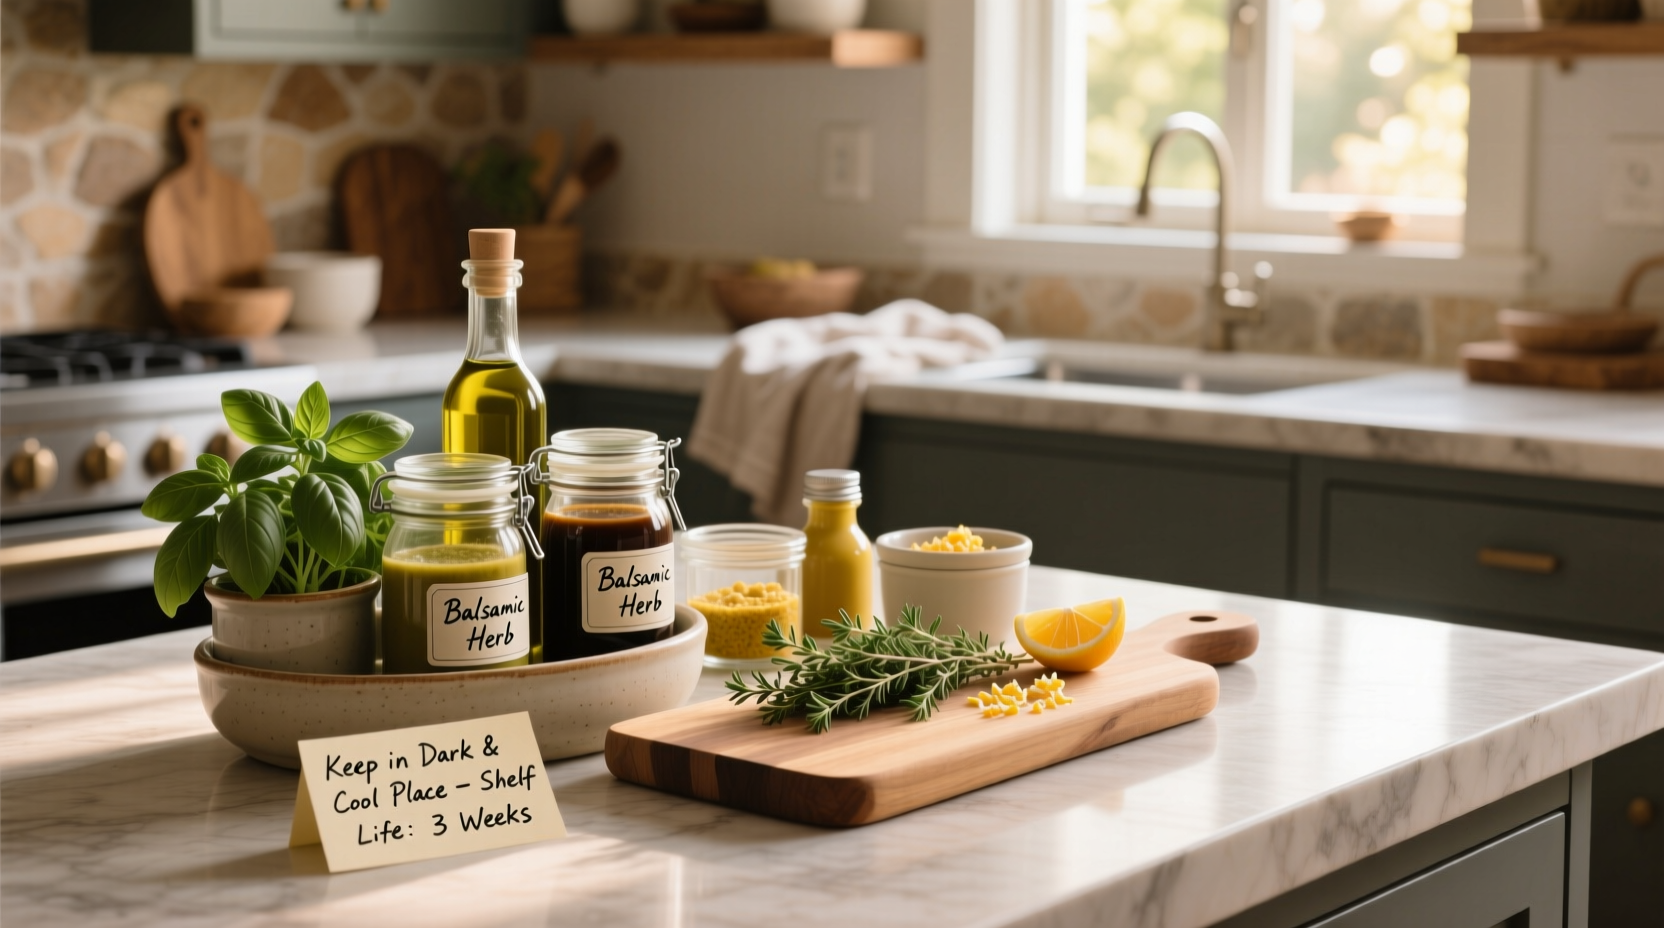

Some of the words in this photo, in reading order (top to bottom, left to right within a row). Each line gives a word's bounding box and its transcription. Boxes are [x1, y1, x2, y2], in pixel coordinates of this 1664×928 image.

[597, 564, 671, 592] Balsamic
[443, 595, 525, 625] Balsamic
[618, 589, 662, 617] Herb
[466, 621, 514, 651] Herb
[325, 754, 378, 784] Keep
[389, 751, 409, 769] in
[418, 738, 474, 767] Dark
[482, 734, 499, 756] &
[333, 787, 379, 813] Cool
[389, 780, 448, 807] Place
[480, 764, 536, 791] Shelf
[357, 820, 413, 845] Life:
[431, 813, 448, 836] 3
[459, 803, 533, 832] Weeks
